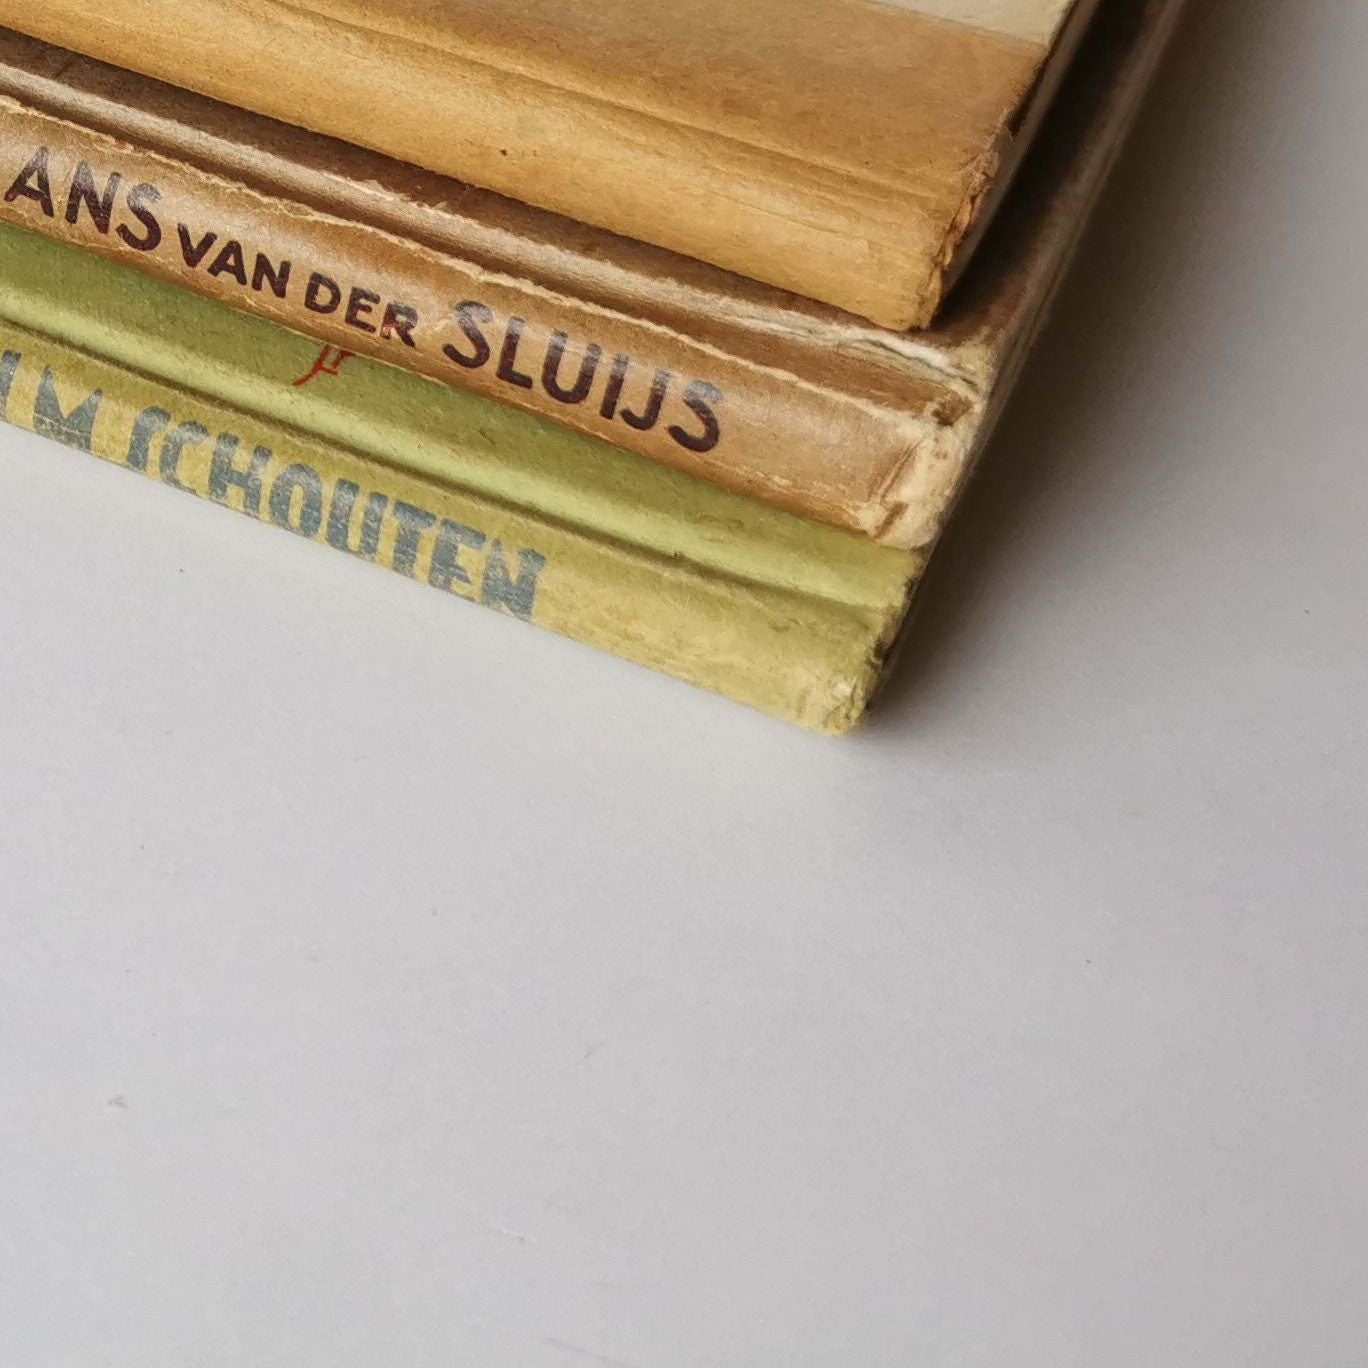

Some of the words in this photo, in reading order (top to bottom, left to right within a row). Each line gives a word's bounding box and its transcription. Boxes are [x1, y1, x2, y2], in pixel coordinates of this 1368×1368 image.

[3, 145, 163, 252] ANS
[177, 221, 292, 299] VAN
[304, 272, 419, 348] DER
[443, 301, 726, 454] SLUIJS
[126, 406, 547, 624] SCHOUTEN
